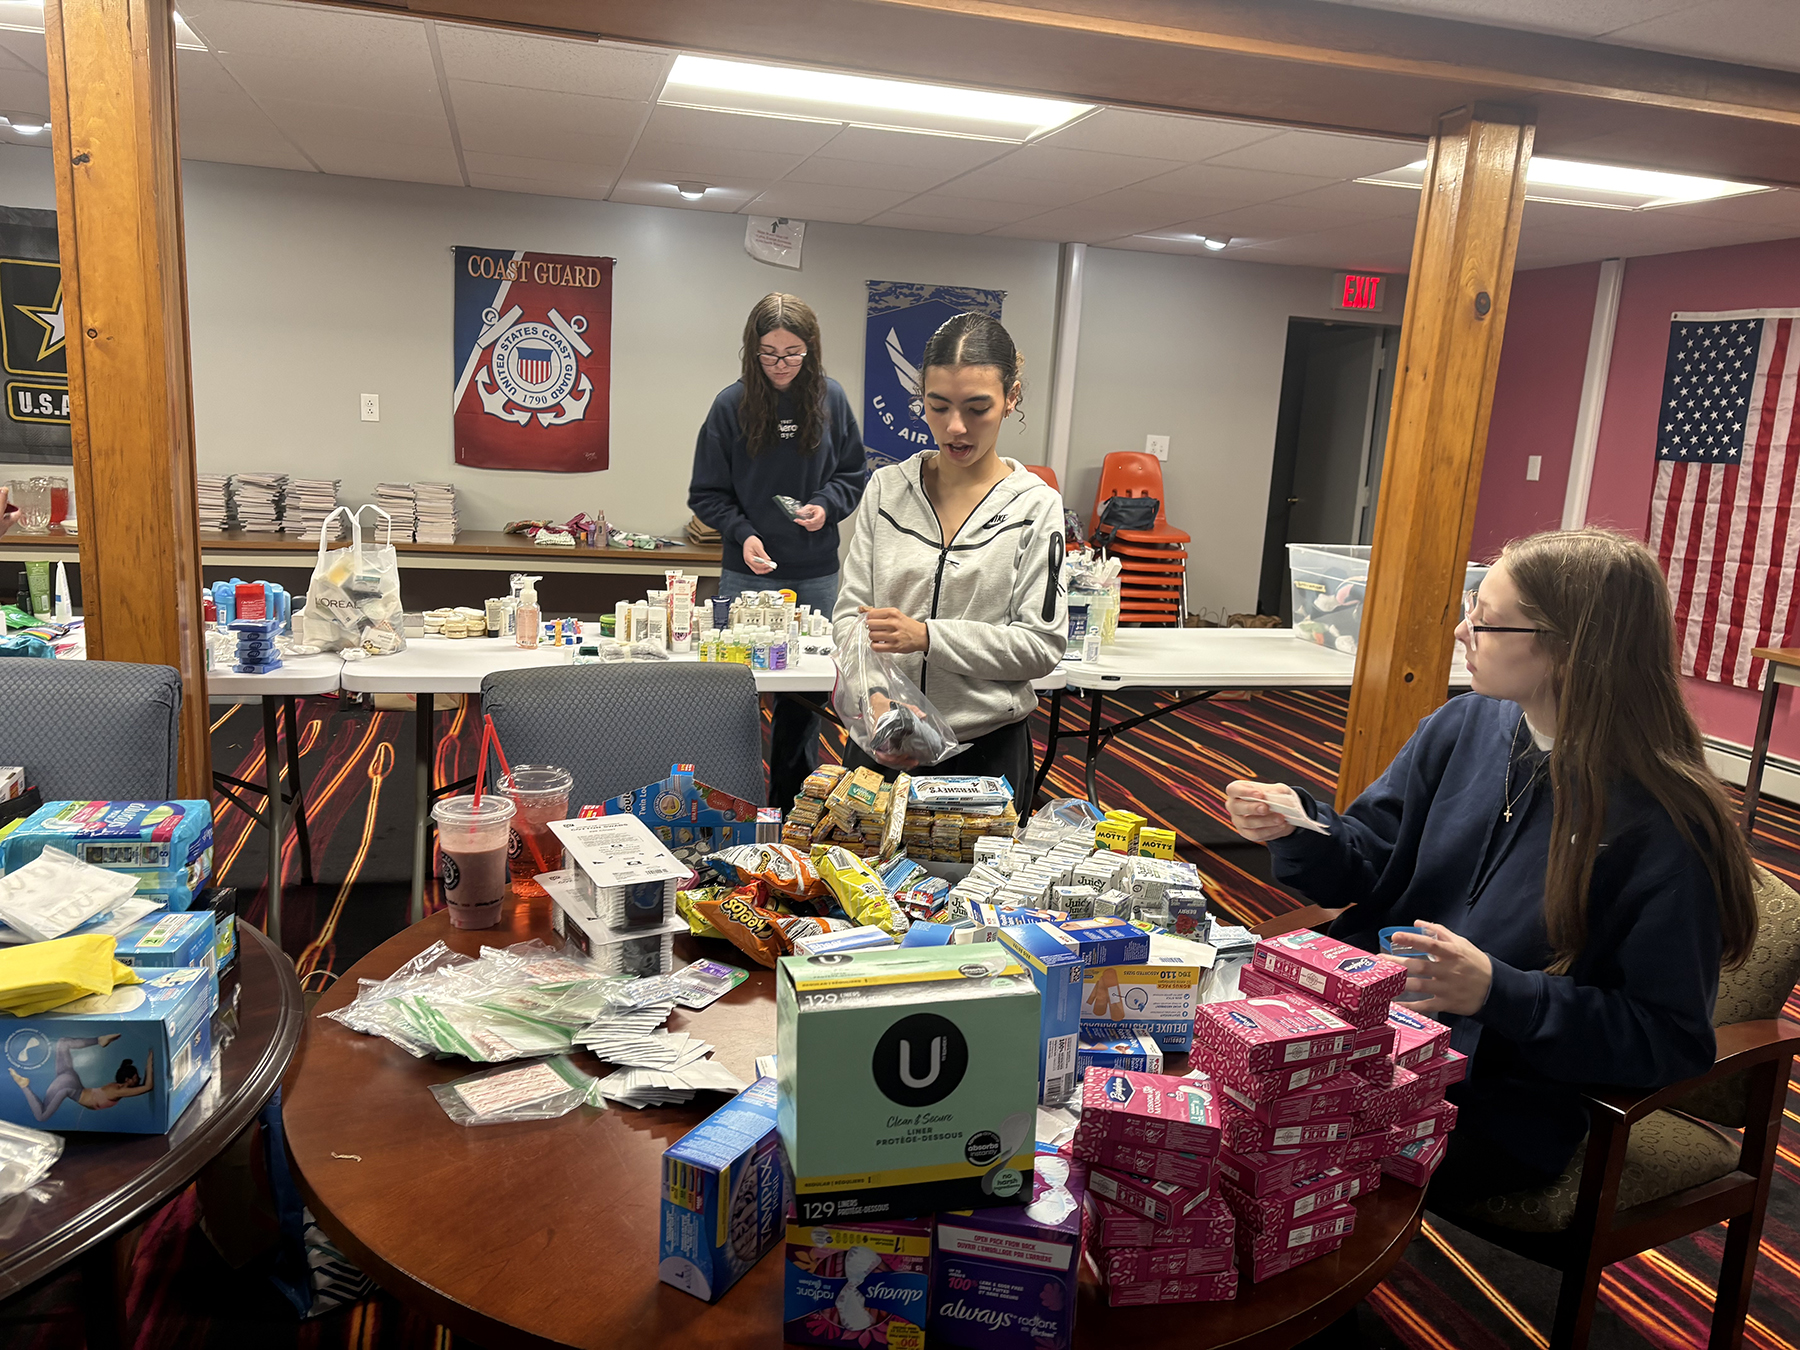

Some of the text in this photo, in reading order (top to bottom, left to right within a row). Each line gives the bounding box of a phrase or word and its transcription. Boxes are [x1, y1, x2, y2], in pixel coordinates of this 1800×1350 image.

[467, 255, 601, 288] COAST GUARD
[1342, 275, 1380, 309] EXIT
[496, 326, 574, 400] UNITED STATES COAST GUARD
[522, 394, 548, 406] 1790
[872, 395, 929, 445] U.S. AIR
[1097, 831, 1126, 842] MOTT'S
[1141, 841, 1172, 850] MOTT'S
[1160, 971, 1176, 979] 110
[805, 993, 838, 1008] 129
[1156, 1023, 1188, 1033] DELUXE
[899, 1035, 944, 1089] U
[886, 1115, 914, 1129] Clean
[922, 1112, 954, 1124] Secure
[876, 1131, 964, 1147] PROTÈGE-DESSOUS
[907, 1127, 933, 1136] LINER
[967, 1142, 999, 1152] absorbs
[970, 1149, 998, 1157] instantly
[997, 1178, 1018, 1186] harsh
[759, 1155, 773, 1250] TAMPAX
[837, 1199, 858, 1208] LINERS
[803, 1201, 835, 1220] 129
[957, 1242, 976, 1250] OUVRIR
[977, 1245, 1012, 1256] L'EMBALLAGE
[974, 1235, 1037, 1250] OPEN PACK FROM BACK
[796, 1286, 834, 1302] radiant
[865, 1281, 923, 1306] always
[939, 1298, 1012, 1331] always
[1017, 1315, 1057, 1331] radiant
